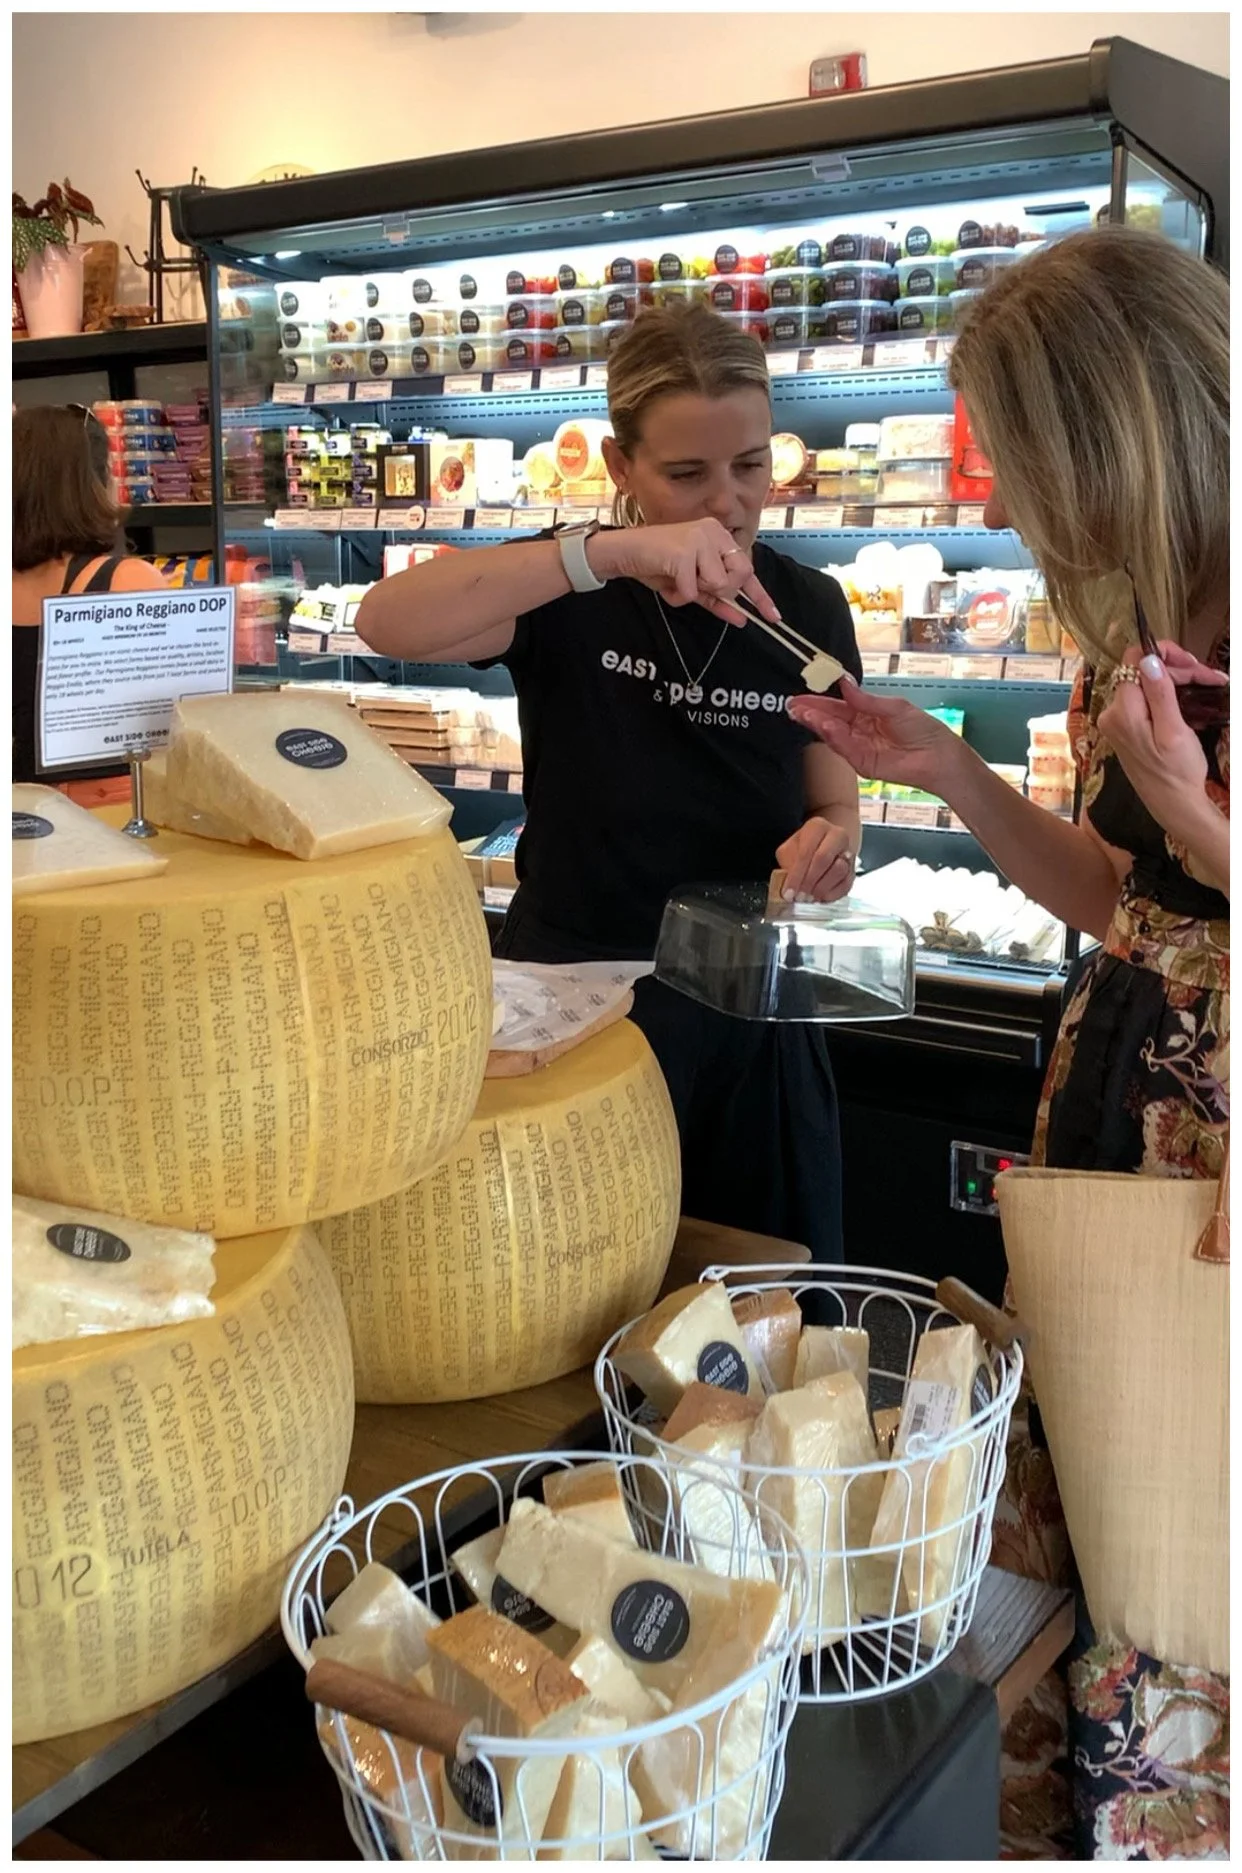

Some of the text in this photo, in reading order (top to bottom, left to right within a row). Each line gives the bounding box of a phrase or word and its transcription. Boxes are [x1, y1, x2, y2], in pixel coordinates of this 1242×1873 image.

[55, 597, 227, 624] Parmigiano Reggiano DOP
[126, 624, 138, 632] King
[13, 1421, 53, 1559] EGGIANO
[45, 1381, 93, 1547] ARMIGIANO
